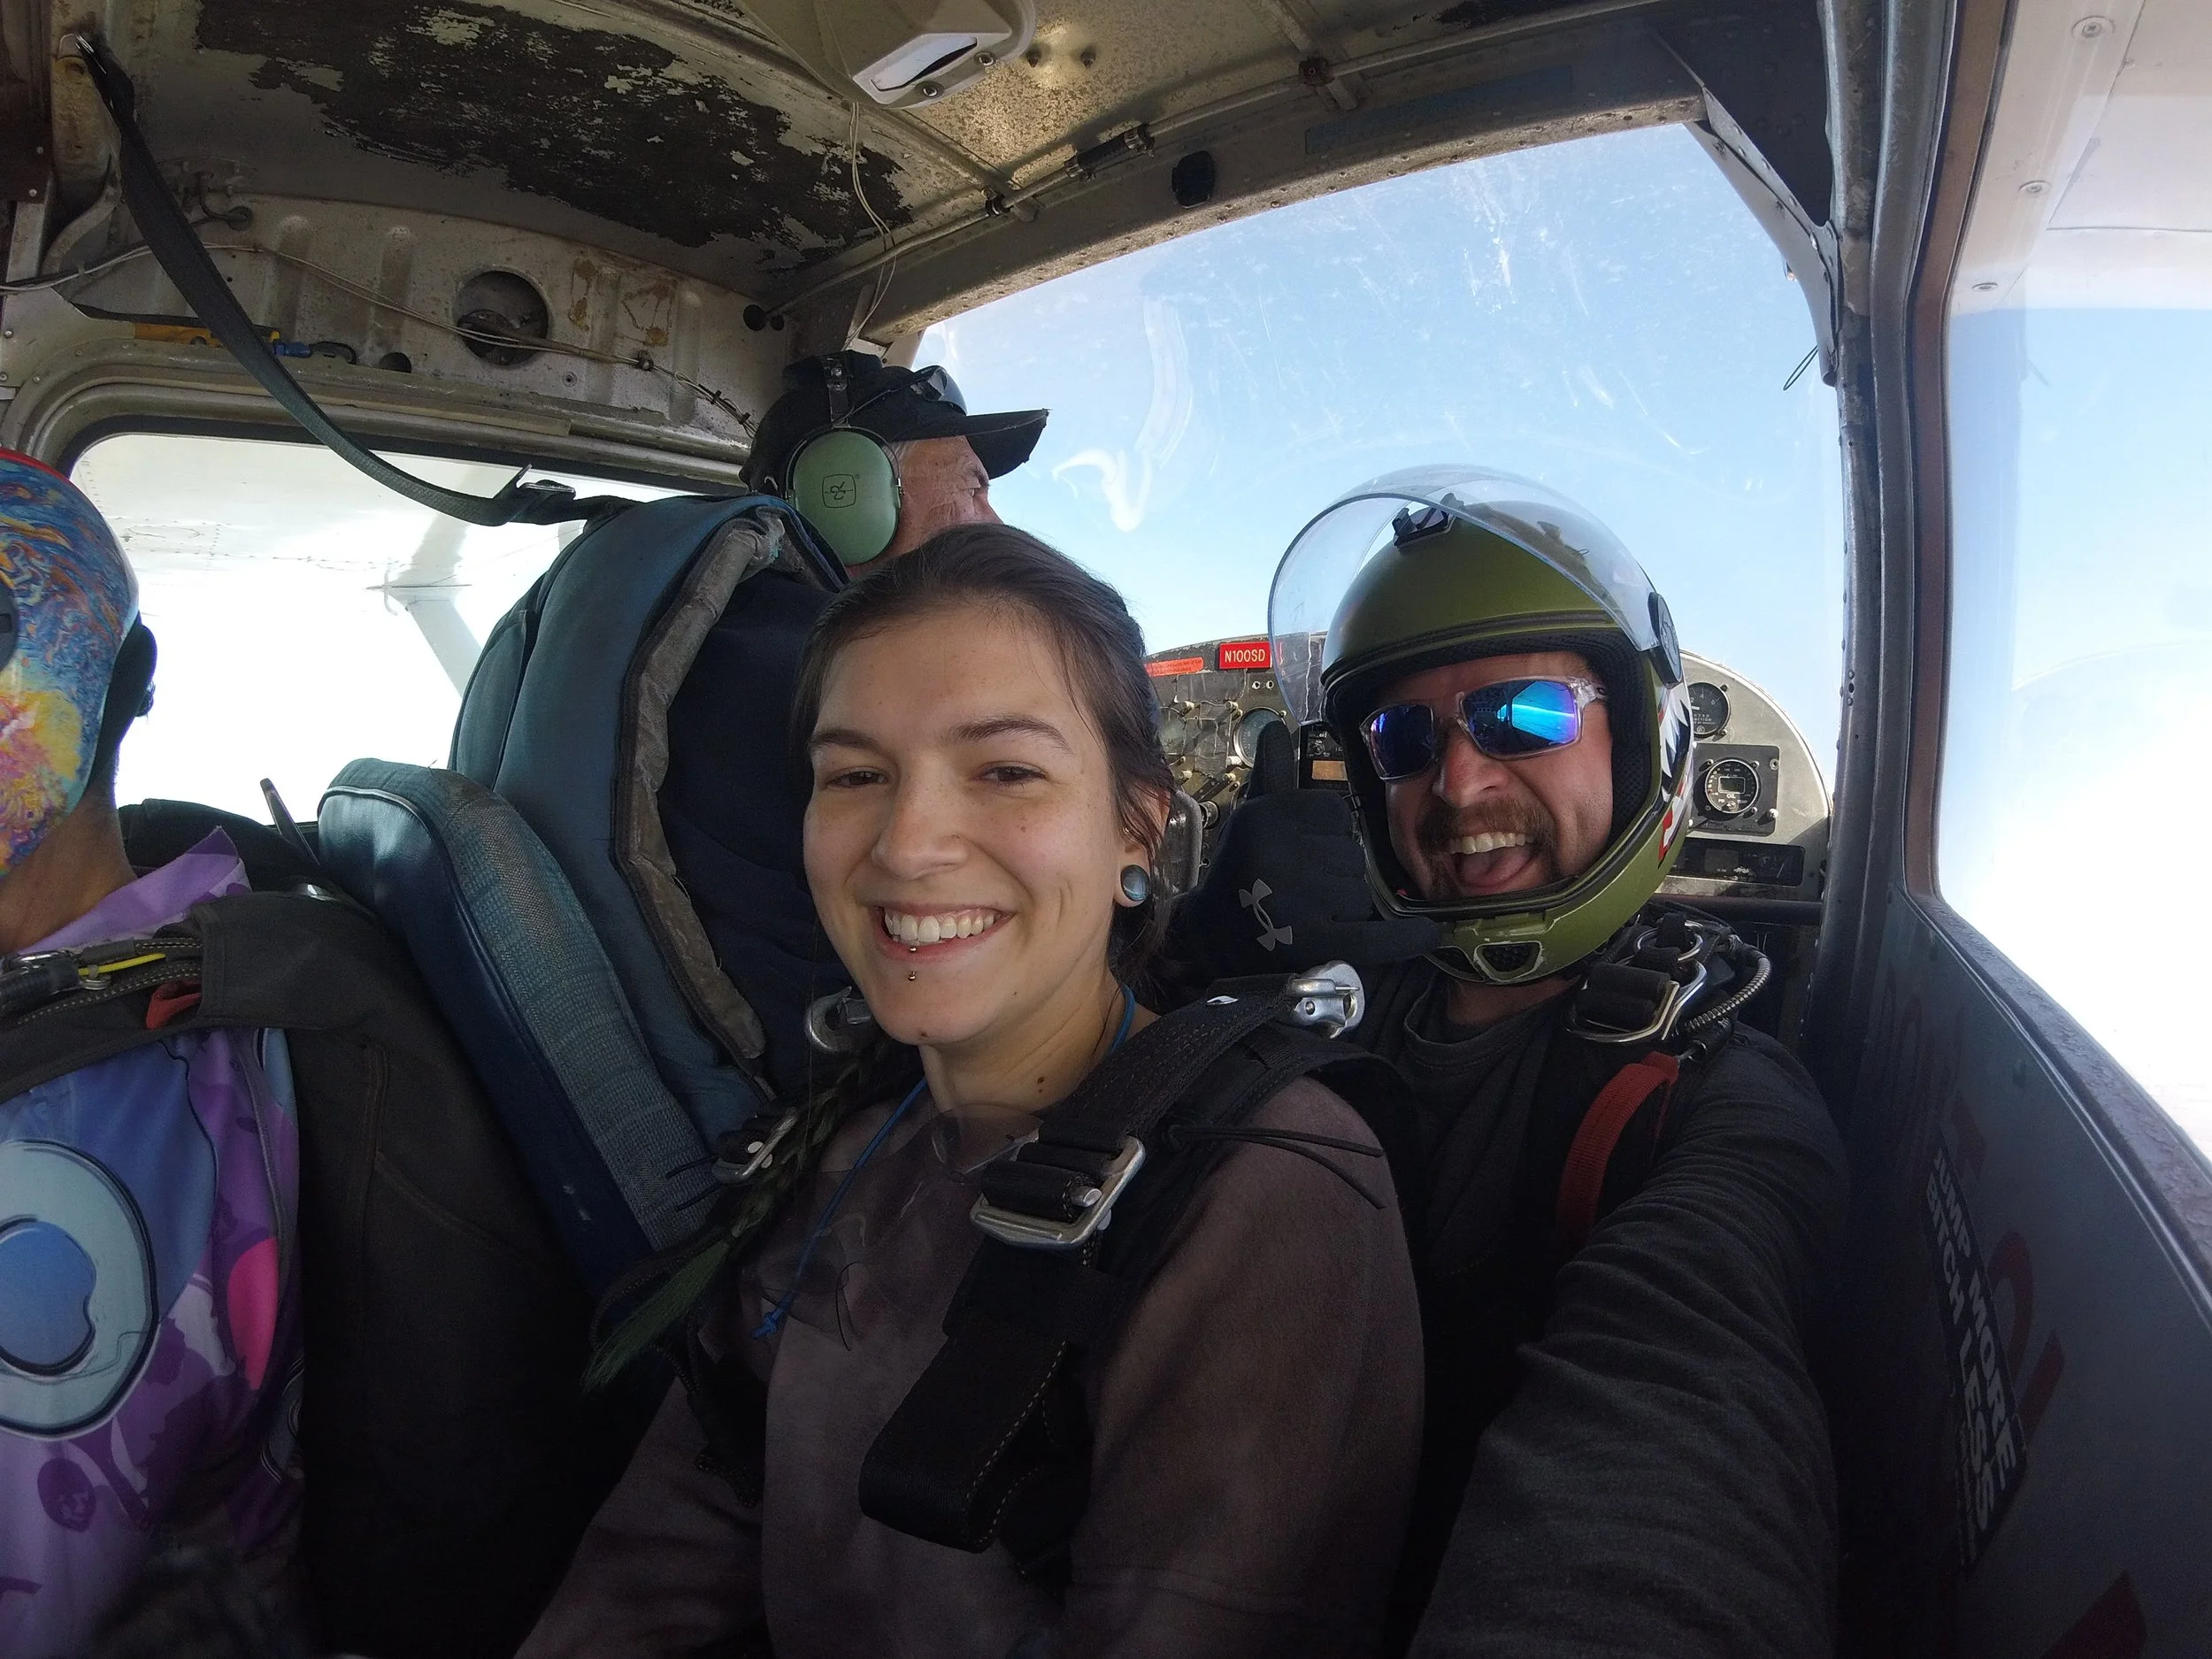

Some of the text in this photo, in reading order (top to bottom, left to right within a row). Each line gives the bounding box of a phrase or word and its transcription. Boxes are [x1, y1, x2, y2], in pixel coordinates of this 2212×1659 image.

[1225, 649, 1265, 663] N100SD
[1926, 1172, 1964, 1325] BITCH
[1959, 1327, 1994, 1531] LESS
[1933, 1148, 2016, 1490] JUMP MORE
